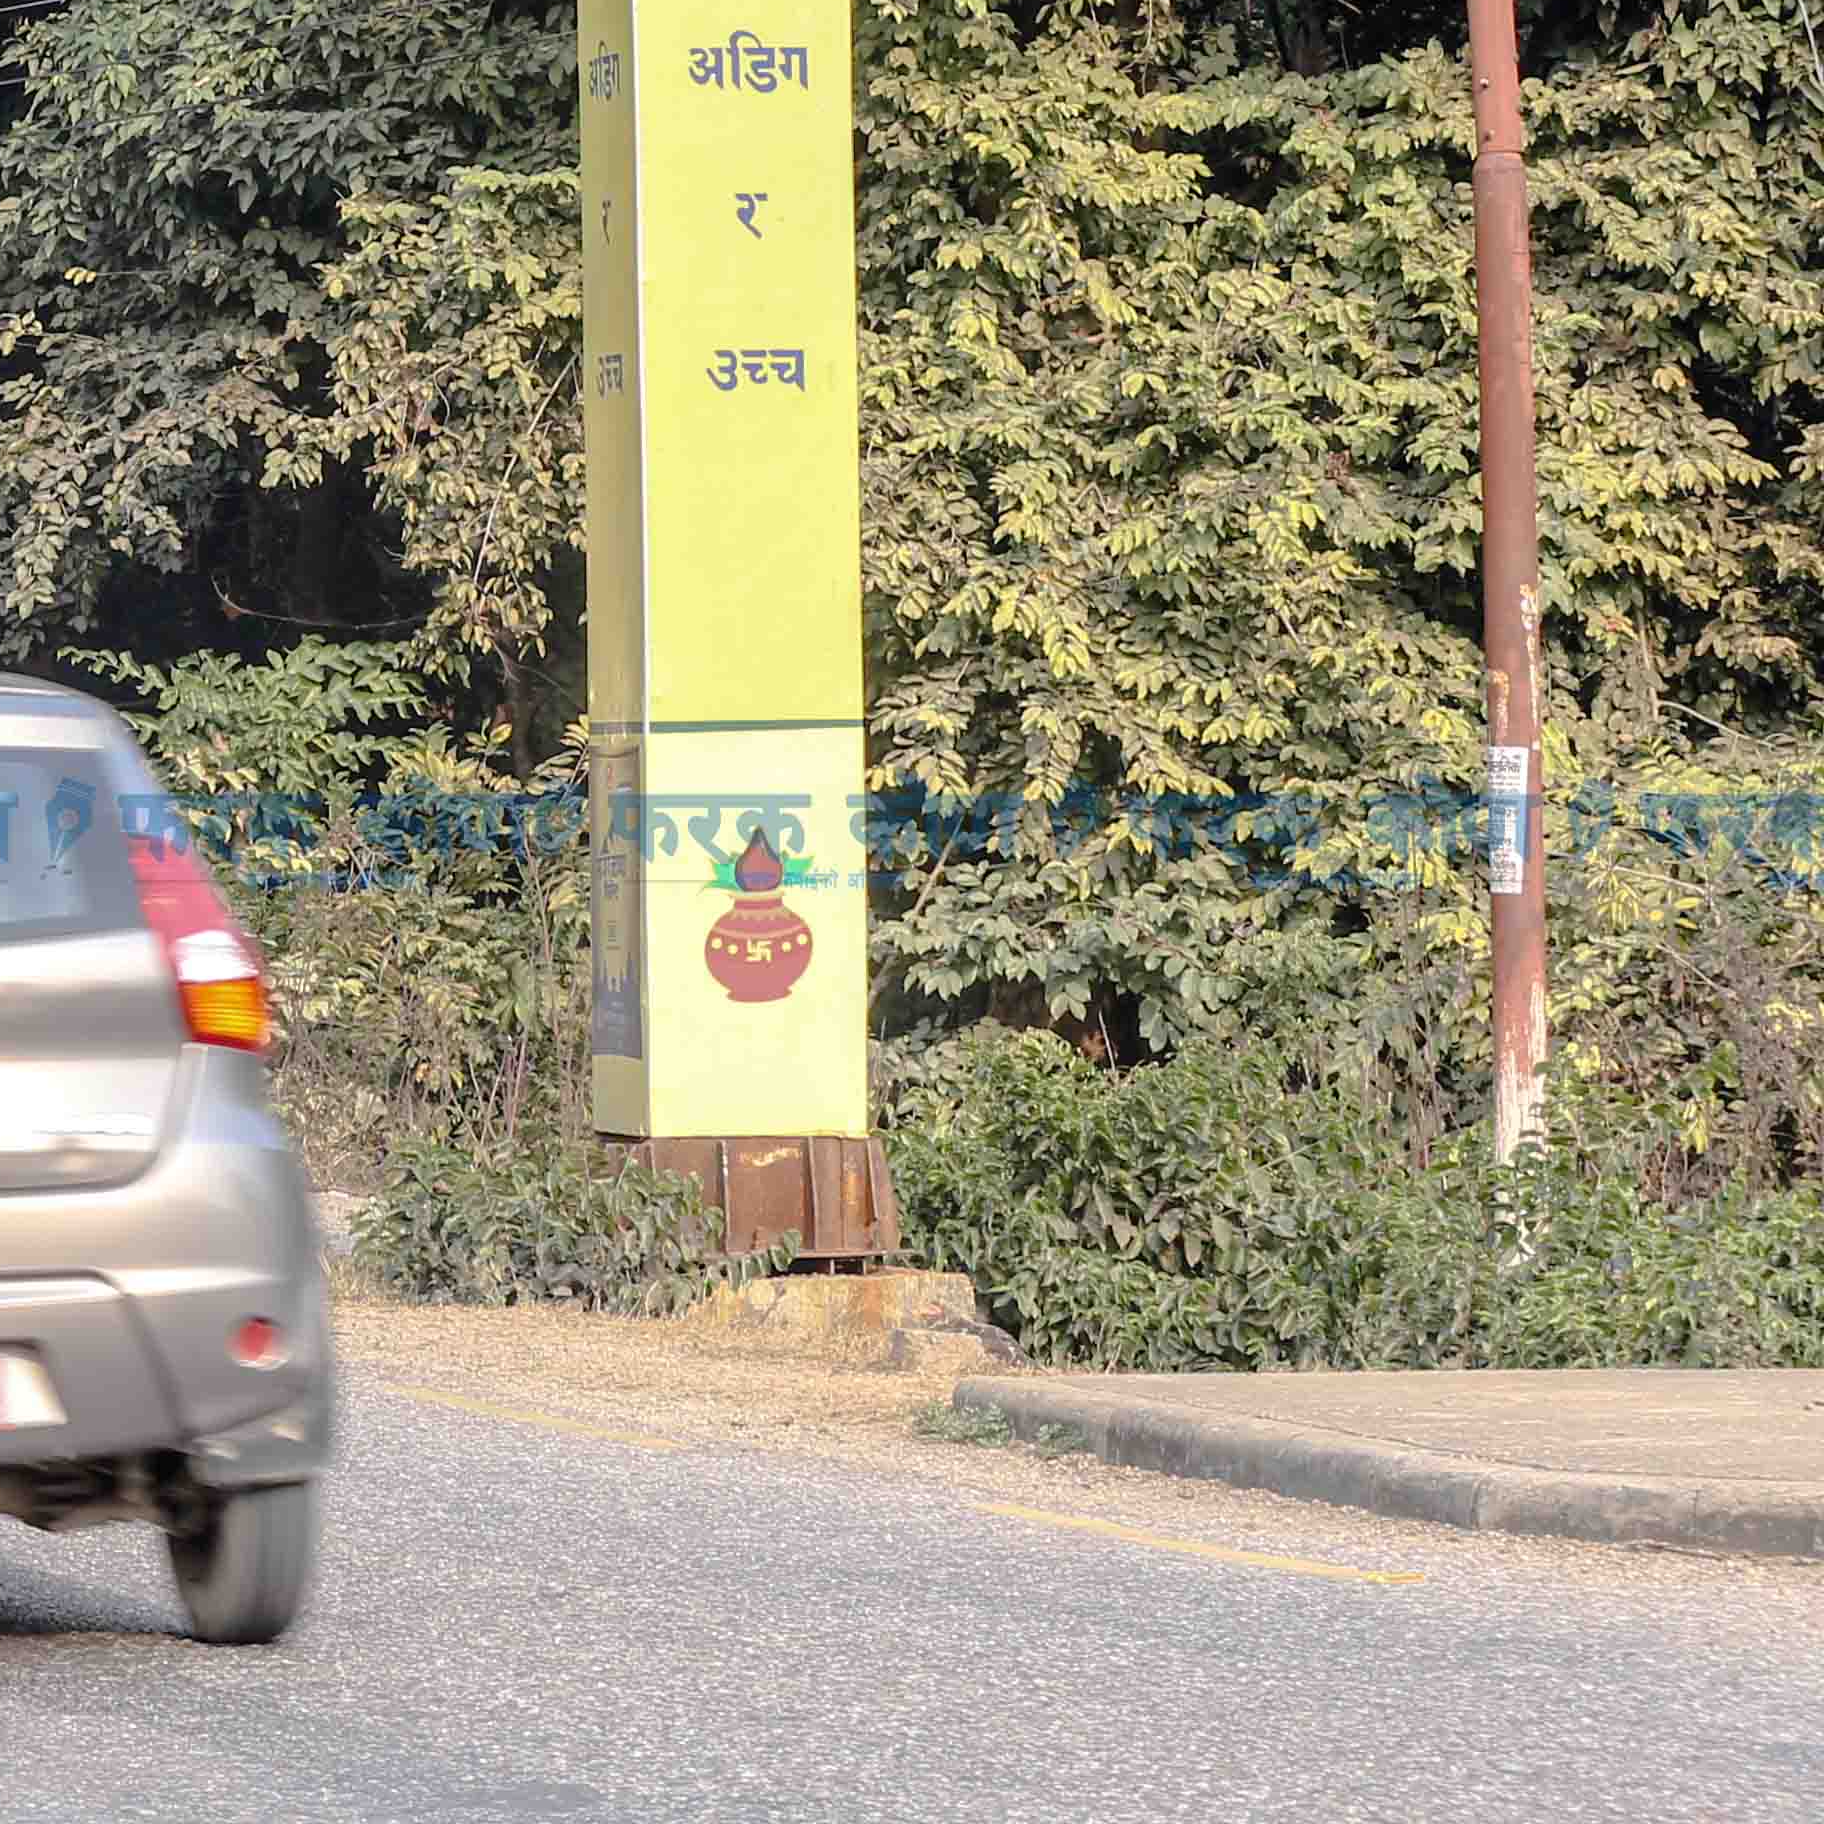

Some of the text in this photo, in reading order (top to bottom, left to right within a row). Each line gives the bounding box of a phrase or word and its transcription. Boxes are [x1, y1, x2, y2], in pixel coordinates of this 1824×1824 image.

[687, 29, 810, 94] अडिग
[735, 192, 768, 240] र
[706, 348, 806, 392] उच्च
